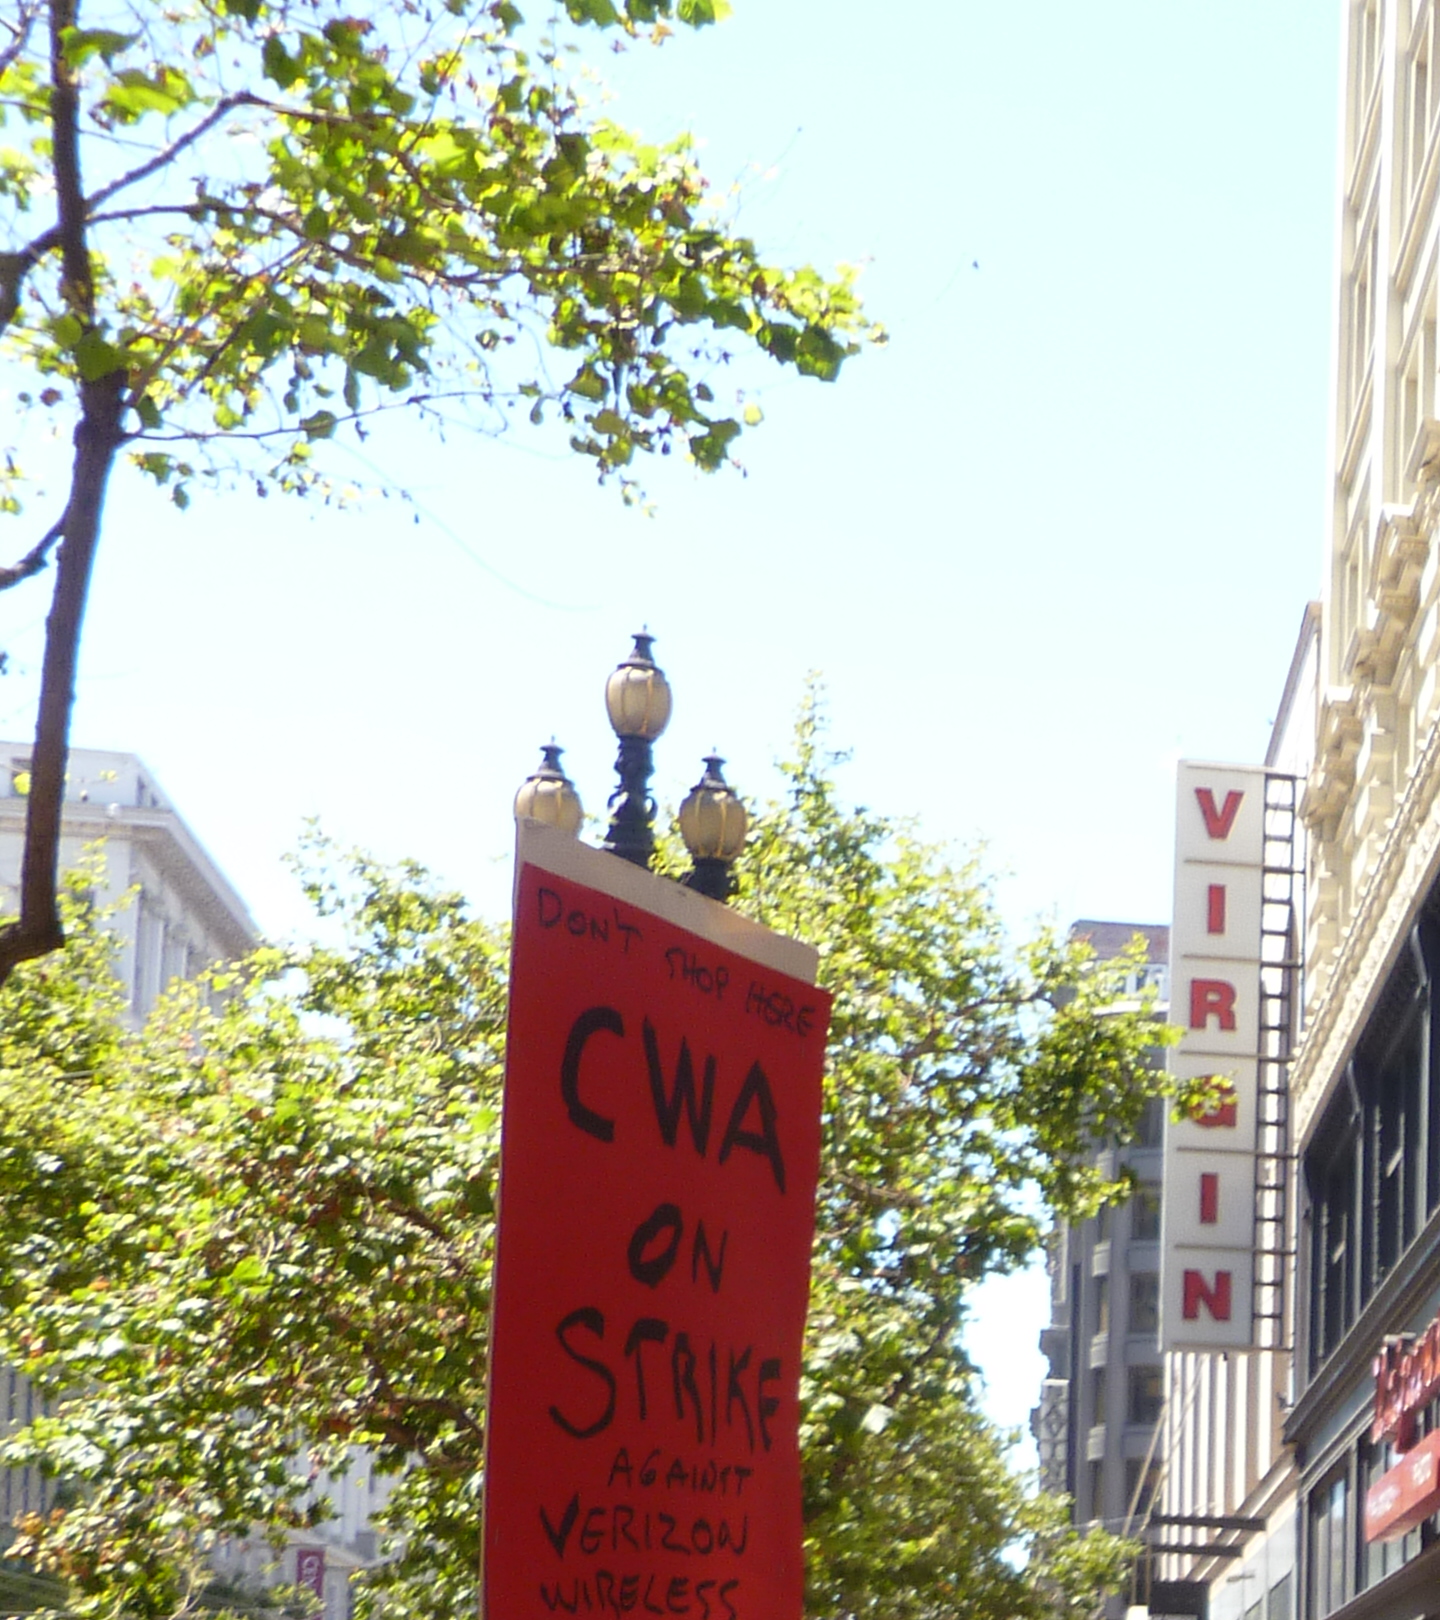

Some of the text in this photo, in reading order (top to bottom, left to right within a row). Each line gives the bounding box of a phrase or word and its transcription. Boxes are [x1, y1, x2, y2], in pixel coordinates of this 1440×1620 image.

[664, 946, 730, 999] SHOP
[744, 982, 816, 1037] HERE
[560, 1005, 786, 1195] CWA
[627, 1203, 728, 1293] ON
[549, 1306, 783, 1452] STRIKE
[607, 1447, 754, 1495] AGAINST
[538, 1493, 749, 1558] VERIZON
